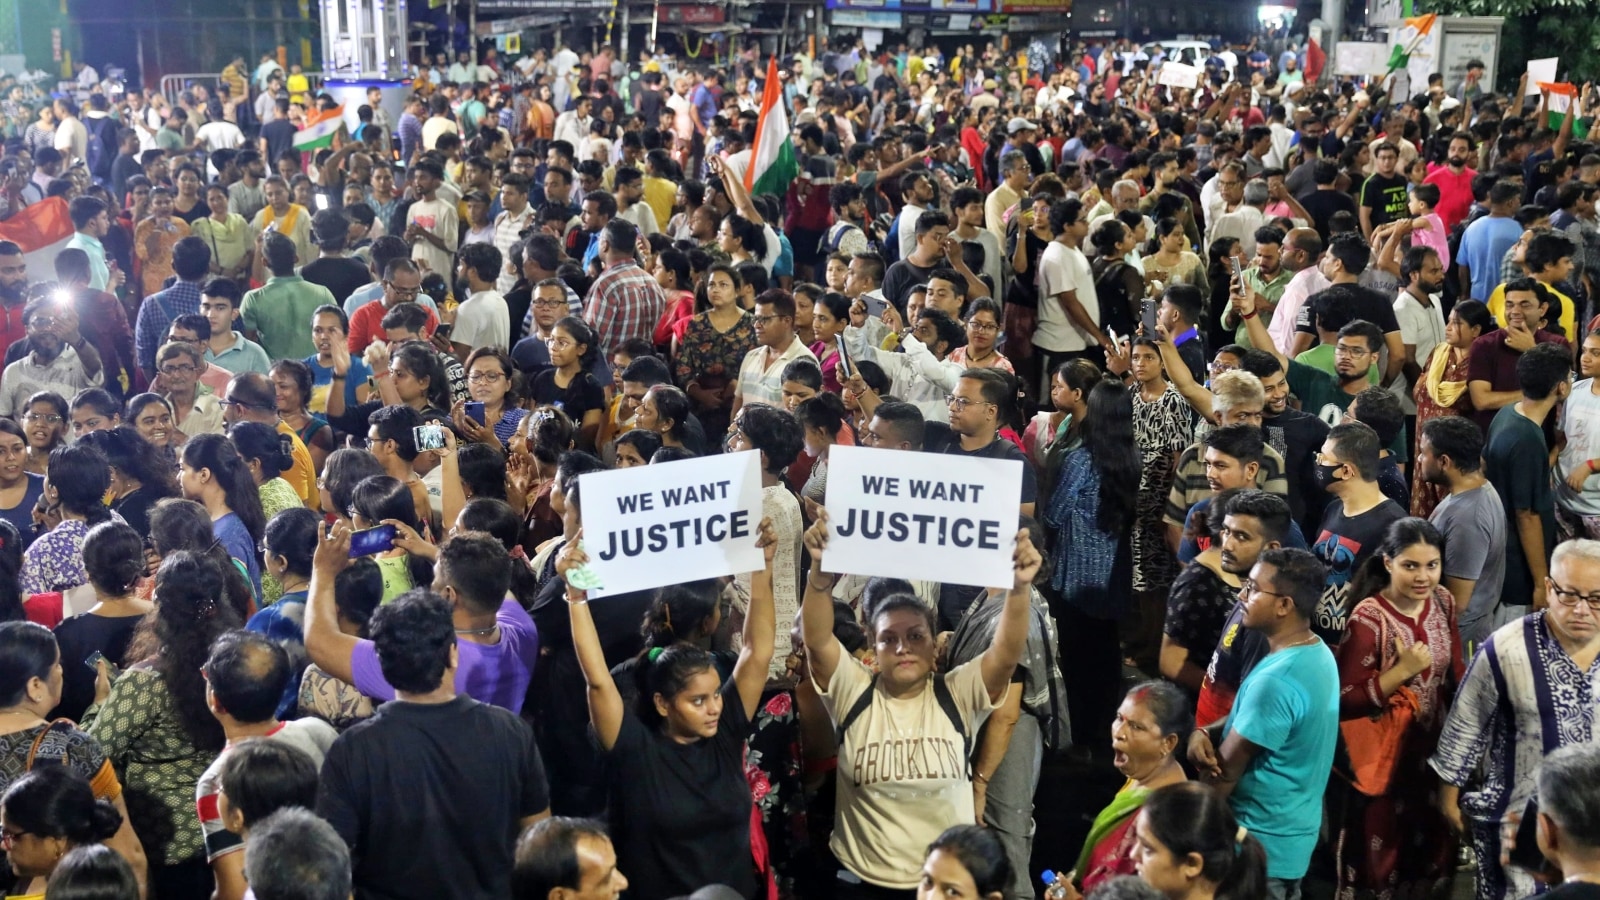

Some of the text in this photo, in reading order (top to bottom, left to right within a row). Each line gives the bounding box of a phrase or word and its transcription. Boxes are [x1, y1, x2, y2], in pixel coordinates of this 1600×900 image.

[617, 480, 731, 515] WE WANT
[862, 475, 984, 503] WE WANT
[599, 510, 749, 561] JUSTICE
[836, 508, 1000, 550] JUSTICE
[854, 736, 963, 787] BROOKLYN
